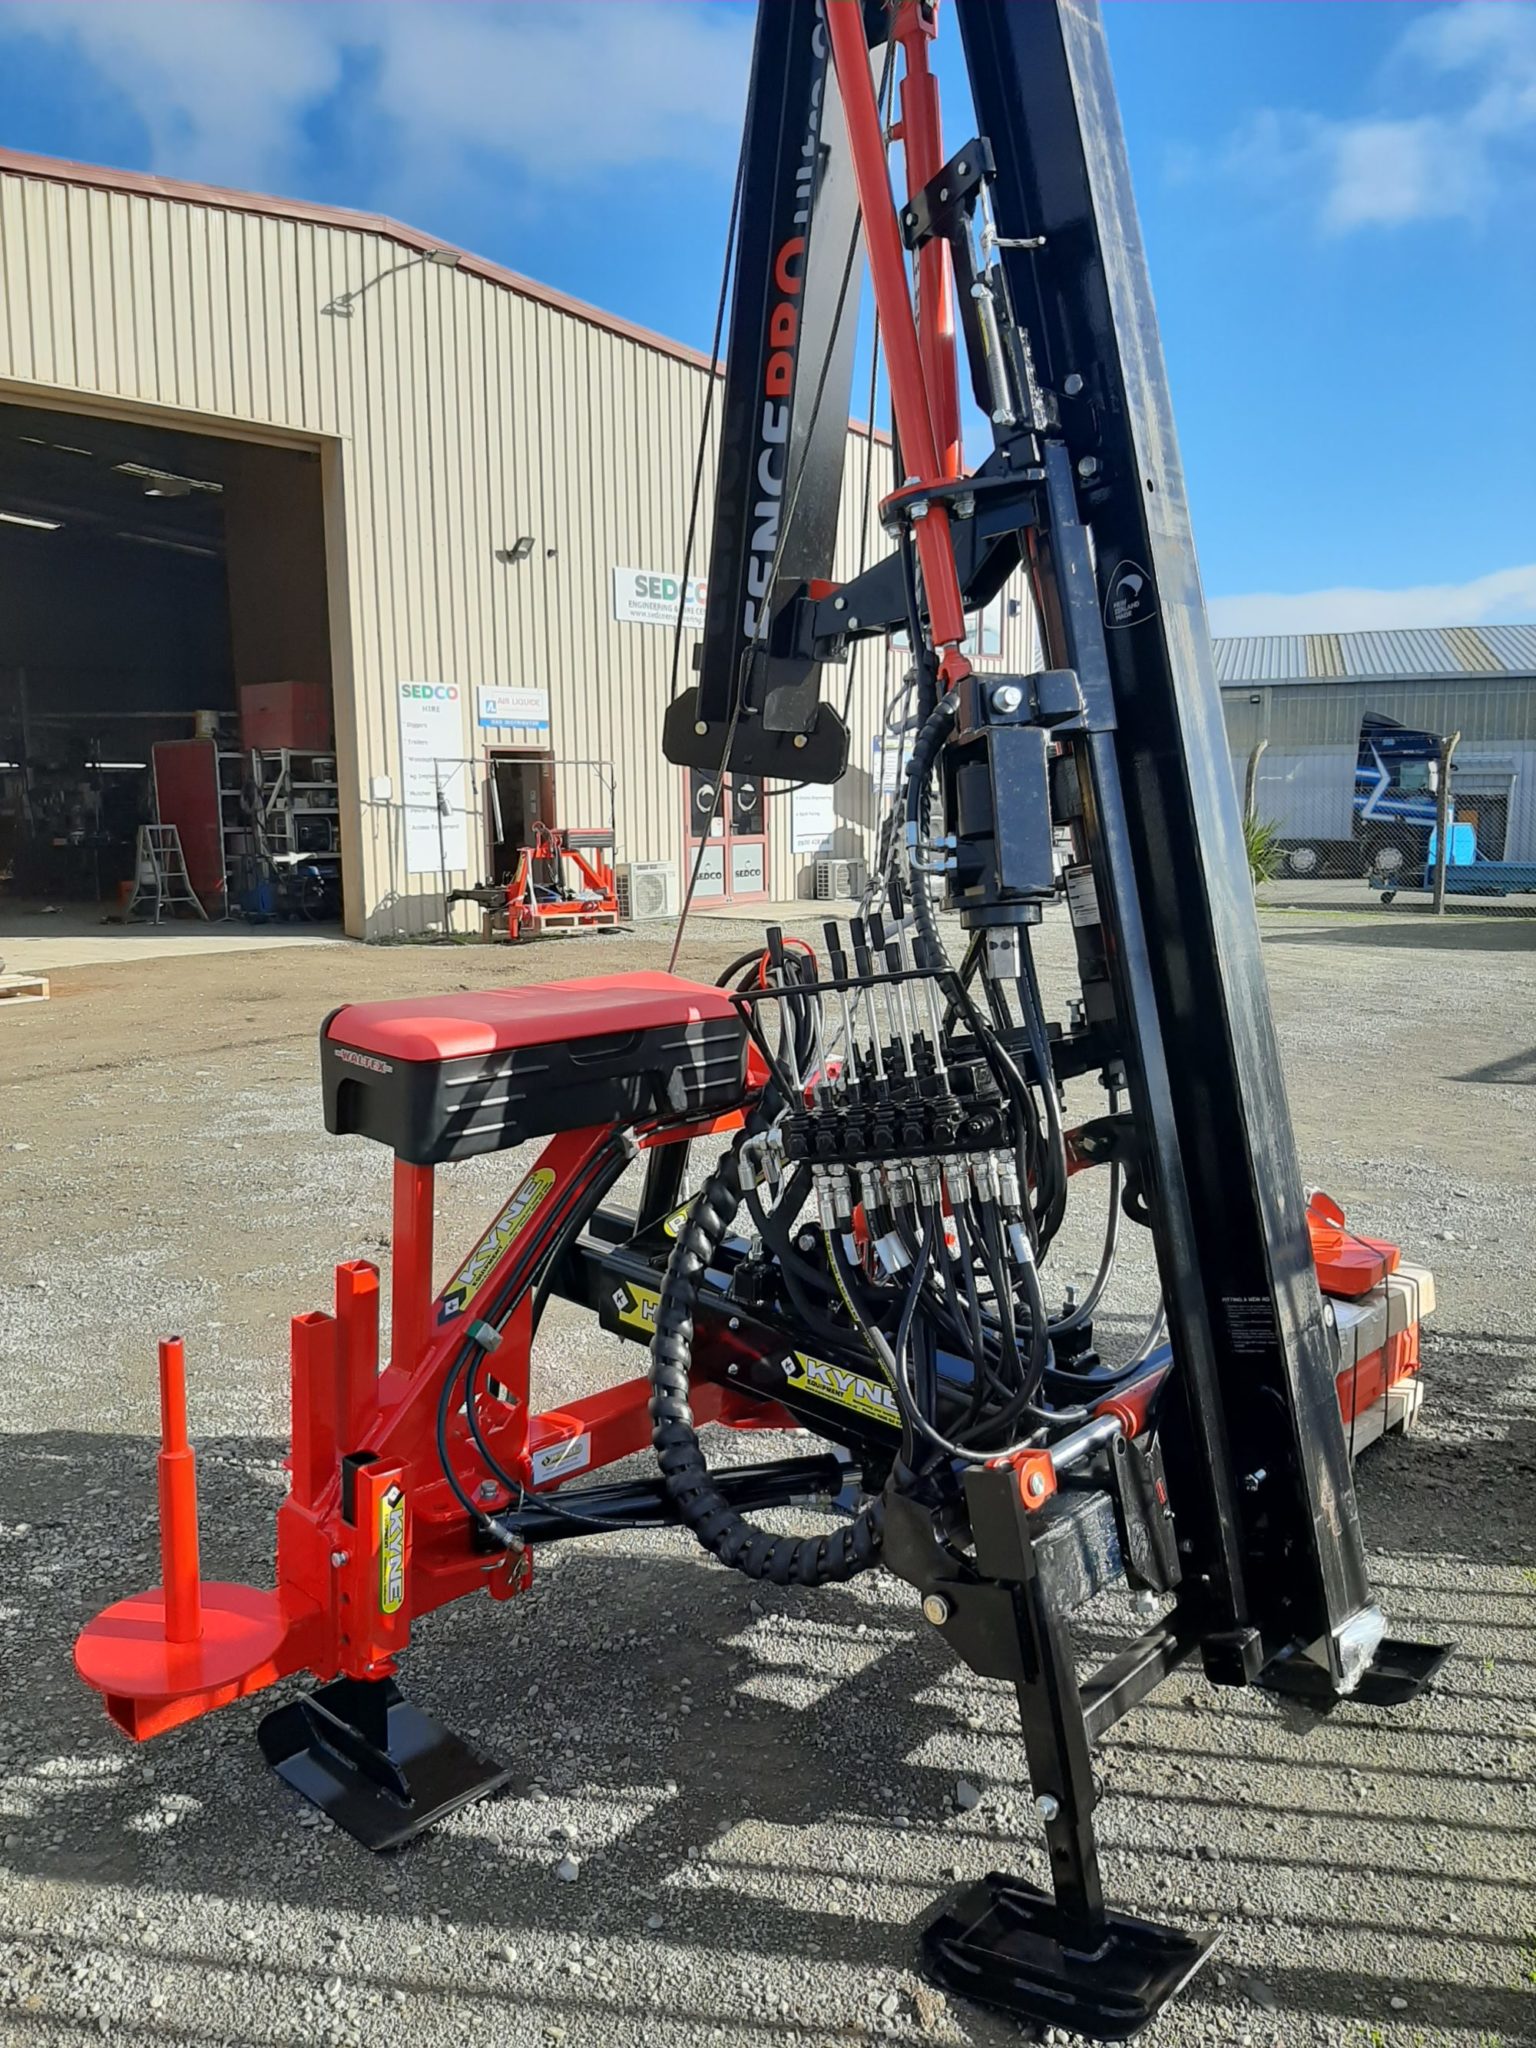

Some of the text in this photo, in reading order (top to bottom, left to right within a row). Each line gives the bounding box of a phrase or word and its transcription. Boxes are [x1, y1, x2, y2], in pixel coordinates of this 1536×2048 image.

[635, 574, 707, 605] SEDCO
[401, 684, 458, 700] SEDCO
[735, 869, 761, 878] SEDCO
[458, 1176, 543, 1284] KYNE
[472, 1245, 503, 1286] EQUIPMENT
[807, 1359, 898, 1411] KYNE
[807, 1379, 844, 1397] EQUIPMENT
[388, 1508, 404, 1603] KYNE
